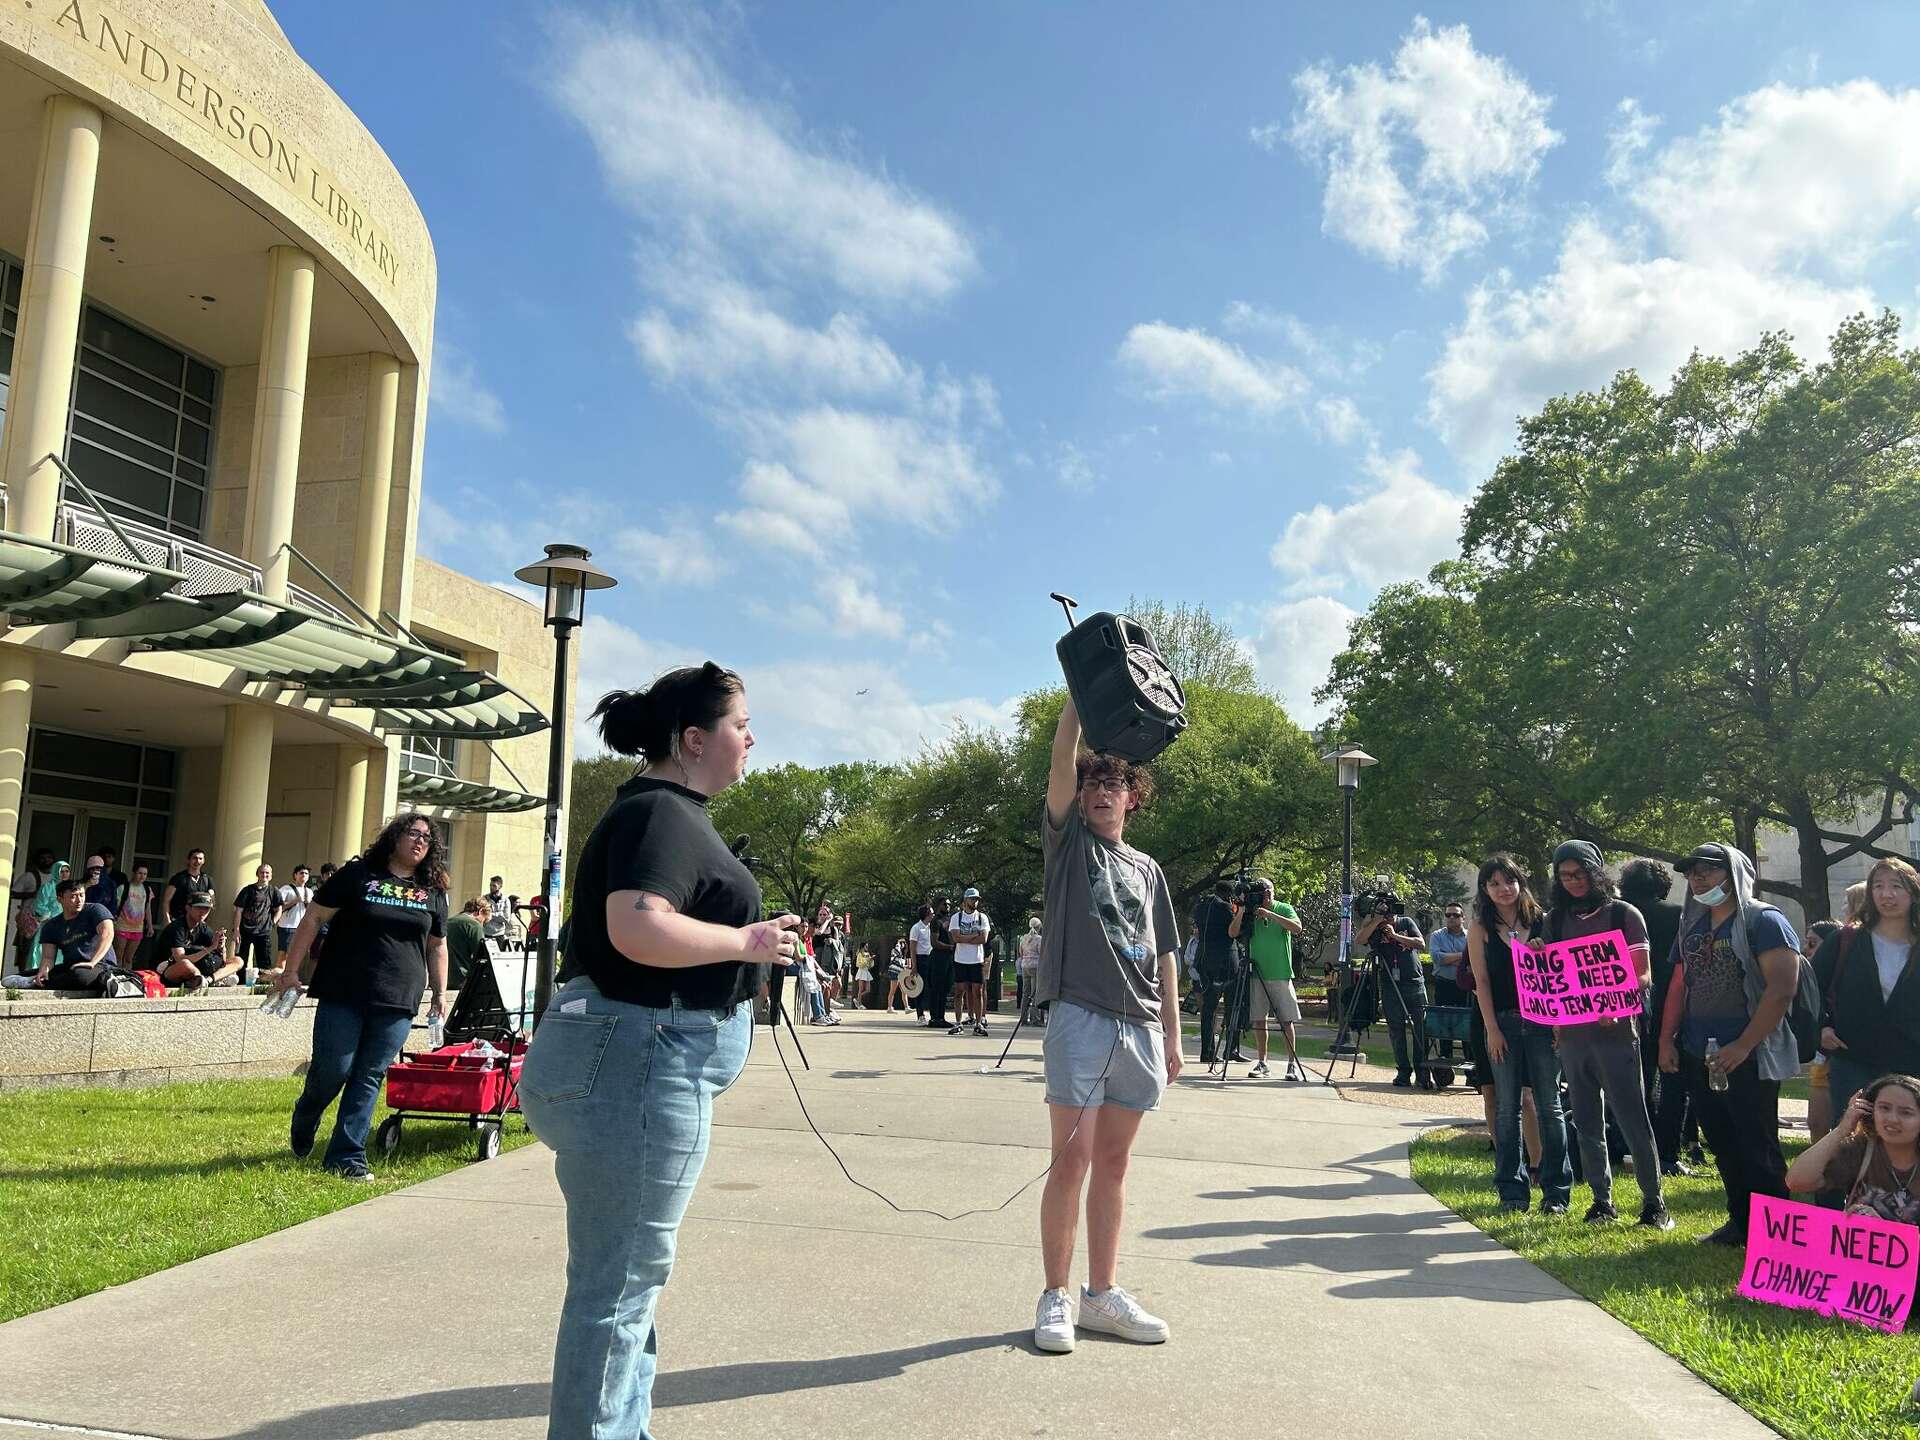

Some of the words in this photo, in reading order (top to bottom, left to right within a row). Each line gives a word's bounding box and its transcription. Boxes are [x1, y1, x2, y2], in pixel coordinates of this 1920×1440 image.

[55, 0, 301, 184] ANDERSON
[311, 168, 399, 286] LIBRARY
[1518, 949, 1564, 973] LONG
[1569, 939, 1620, 967] TERM
[1520, 972, 1569, 995] ISSUES
[1577, 964, 1628, 989] NEED
[1523, 996, 1559, 1017] LONG
[1560, 993, 1593, 1015] TERM
[1764, 1205, 1808, 1248] WE
[1830, 1224, 1910, 1269] NEED
[1750, 1256, 1838, 1303] CHANGE
[1845, 1280, 1907, 1319] NOW
